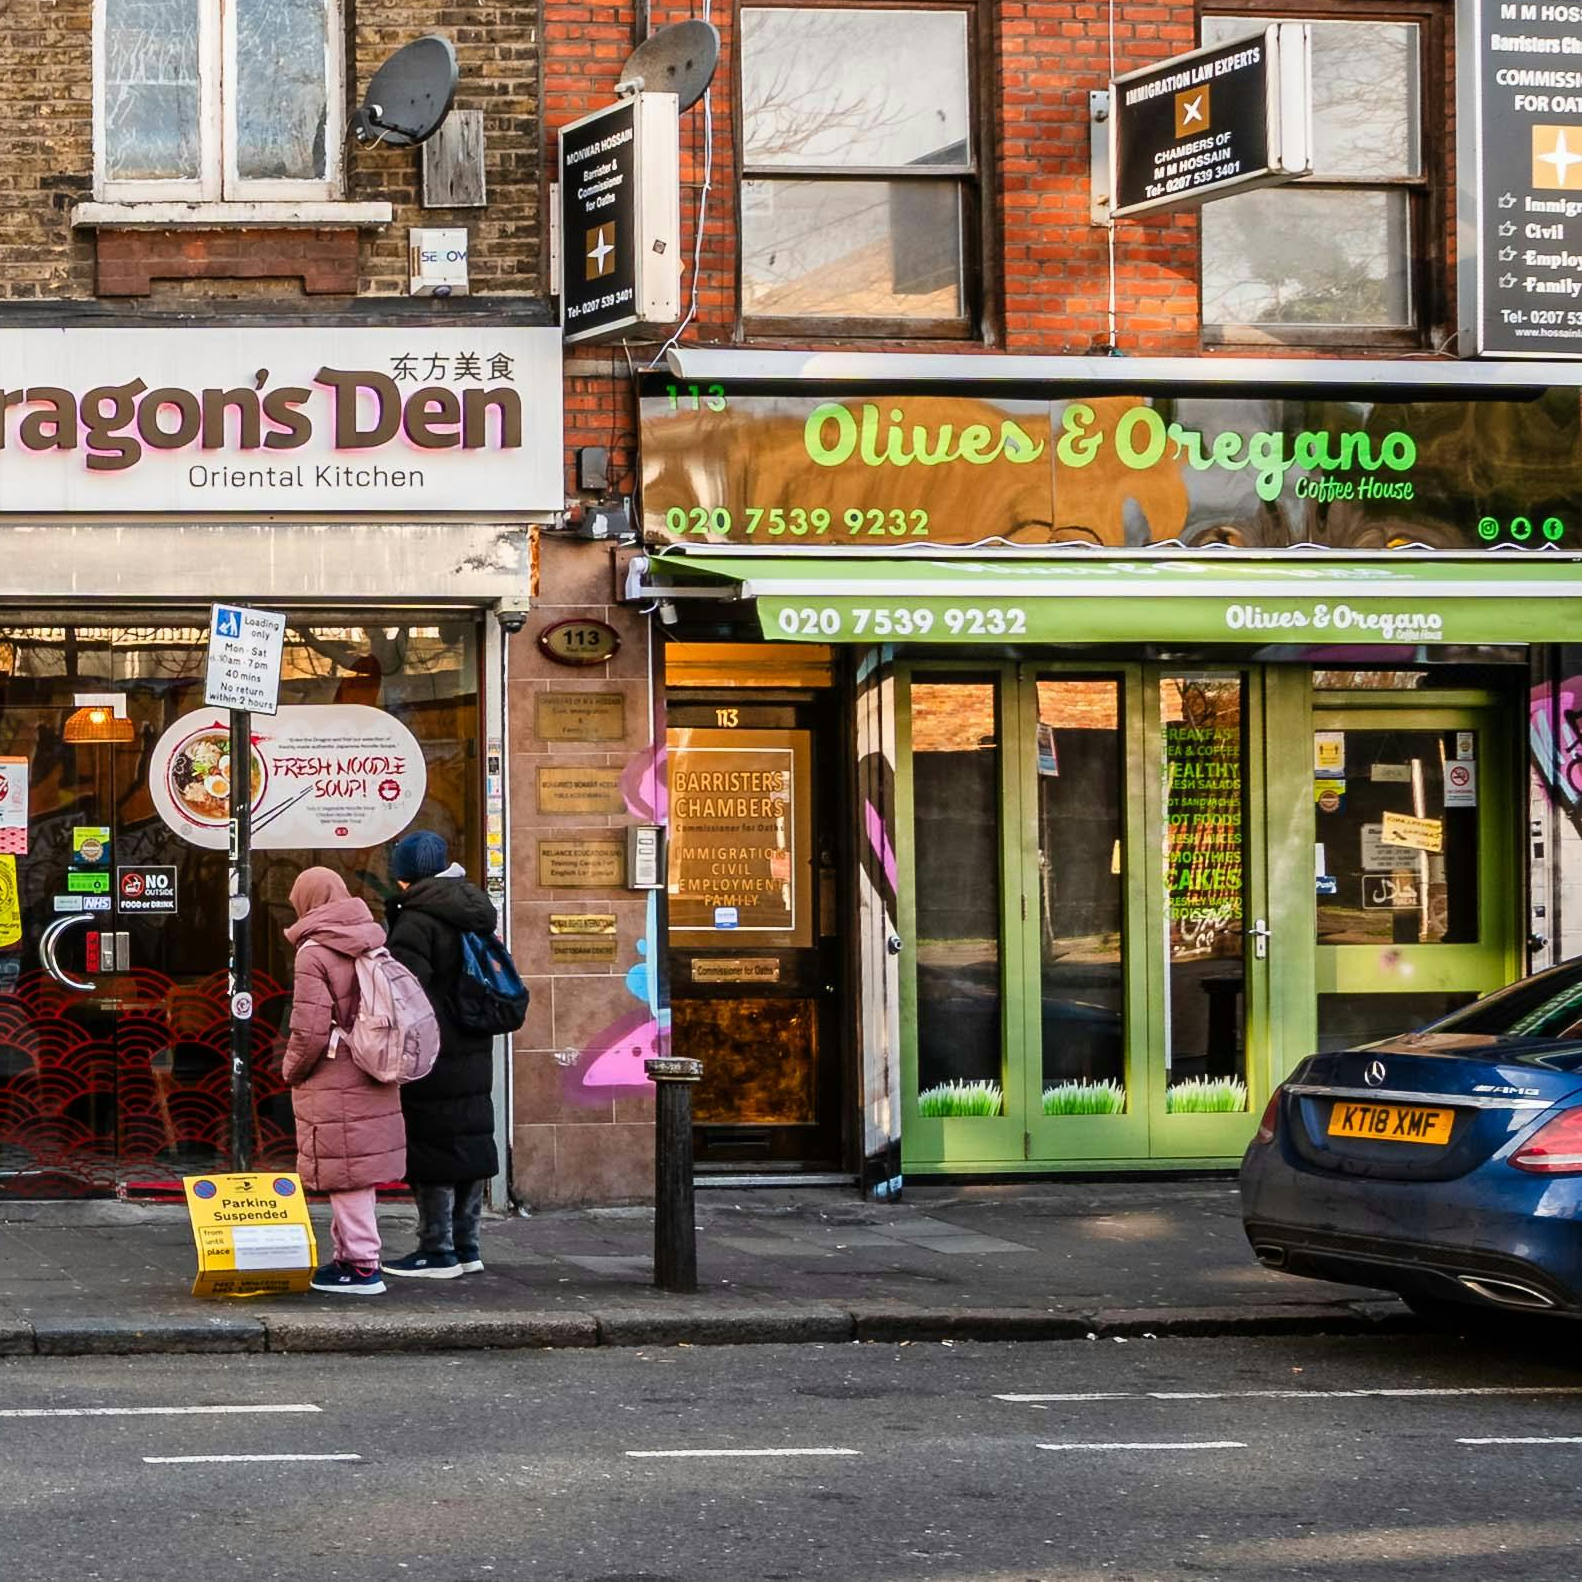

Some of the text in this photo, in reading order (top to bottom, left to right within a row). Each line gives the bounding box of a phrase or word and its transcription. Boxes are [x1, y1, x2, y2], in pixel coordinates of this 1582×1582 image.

[1501, 4, 1536, 20] M M
[1491, 34, 1560, 54] Barristers
[1125, 47, 1261, 106] IMMIGRATION LAW EXPERTS
[1514, 95, 1549, 112] FOR
[566, 127, 633, 166] MONWAR HOSSAIN
[1154, 131, 1232, 164] CHAMBERS OF
[583, 159, 618, 182] Barrister &
[1154, 147, 1231, 181] M M HOSSAIN
[577, 173, 624, 200] Commissioner
[1145, 160, 1241, 199] Tel- 0207 539 3401
[585, 193, 616, 212] for Oaths
[1525, 223, 1564, 240] Civil
[1522, 276, 1582, 298] Family
[567, 287, 633, 319] Tel- 0207 539 3401
[1500, 309, 1563, 325] Tel- 0207
[390, 351, 516, 383] 东方美食
[665, 384, 728, 413] 113
[313, 366, 523, 450] Den
[803, 402, 1418, 502] Olives & Oregano
[189, 465, 425, 489] Oriental Kitchen
[1295, 475, 1415, 504] Coffee House
[665, 506, 930, 536] 020 7539 9232
[245, 617, 279, 631] Loading
[777, 607, 1027, 636] 020 7539 9232
[1225, 603, 1443, 640] Olives & Oregano
[252, 630, 270, 641] only
[563, 630, 600, 646] 113
[225, 643, 267, 657] Mon Sat
[225, 670, 261, 683] 40 mins
[221, 682, 264, 696] No return
[210, 692, 236, 703] within
[248, 698, 273, 709] hours
[716, 709, 739, 727] 113
[1161, 728, 1240, 739] BREAKFAST
[1162, 746, 1240, 756] TEA & COFFEE
[272, 756, 407, 778] FRESH NOODLE
[314, 779, 367, 798] SOUP!
[676, 772, 783, 792] BARRISTERS
[1198, 779, 1241, 789] SALADS
[676, 798, 784, 818] CHAMBERS
[676, 824, 755, 832] Commissioner for
[1193, 814, 1241, 826] FOODS
[1203, 834, 1242, 843] JUICES
[676, 848, 786, 860] IMMIGRATION
[712, 863, 751, 875] CIVIL
[146, 875, 168, 888] NO
[679, 879, 783, 891] EMPLOYMENT
[1163, 869, 1242, 890] CAKES
[84, 898, 109, 909] NHS
[704, 895, 759, 907] FAMILY
[697, 966, 755, 976] Commissioner for
[1492, 1086, 1540, 1095] AMG
[1341, 1106, 1440, 1137] KT18 XMF
[222, 1198, 277, 1208] Parking
[214, 1210, 288, 1222] Suspended
